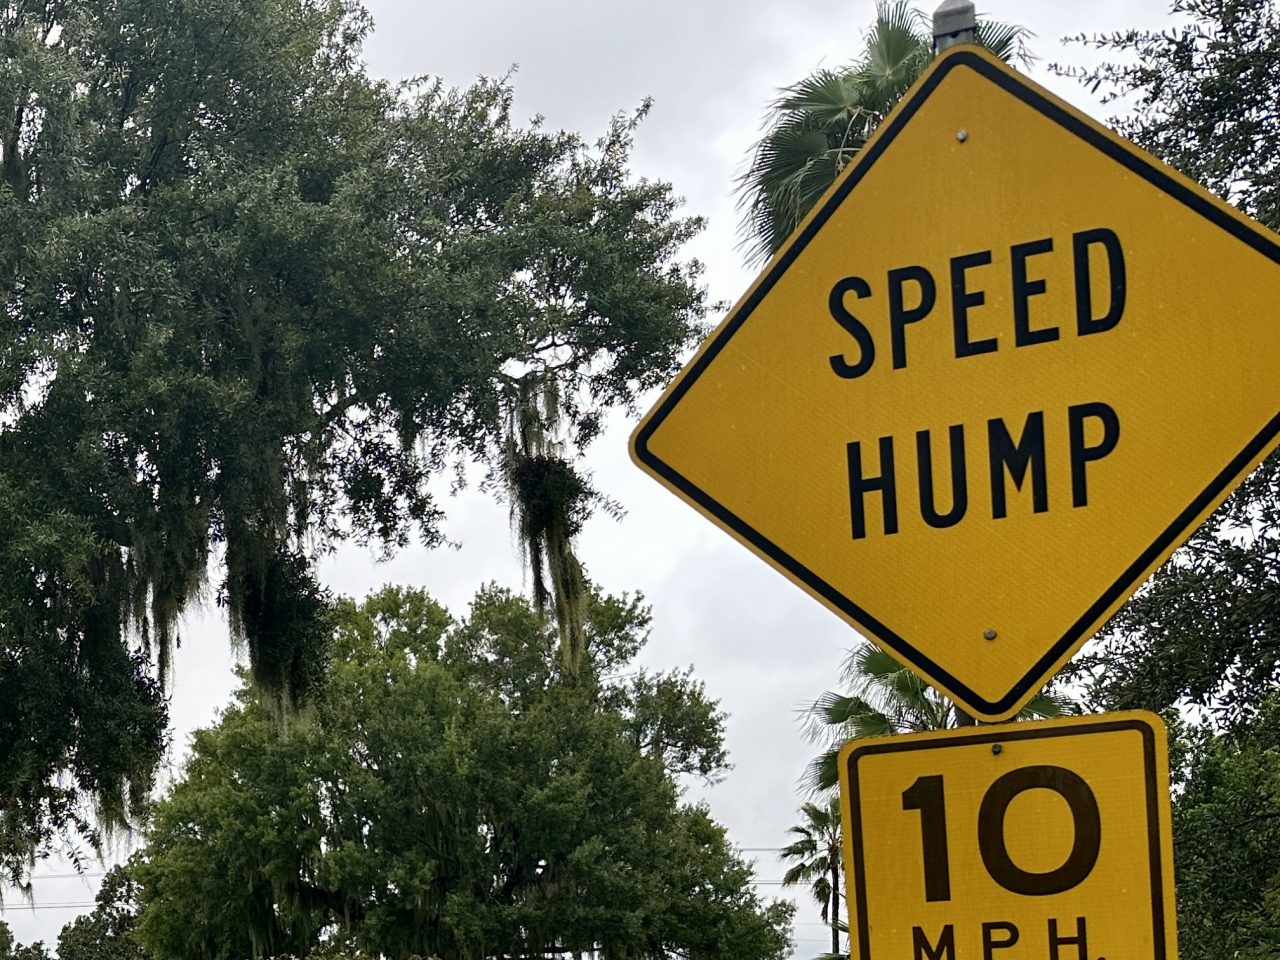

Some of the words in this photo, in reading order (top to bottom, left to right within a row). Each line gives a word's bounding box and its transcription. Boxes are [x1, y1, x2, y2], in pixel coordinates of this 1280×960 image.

[827, 227, 1127, 379] SPEED
[846, 402, 1121, 540] HUMP
[902, 764, 1101, 903] 10
